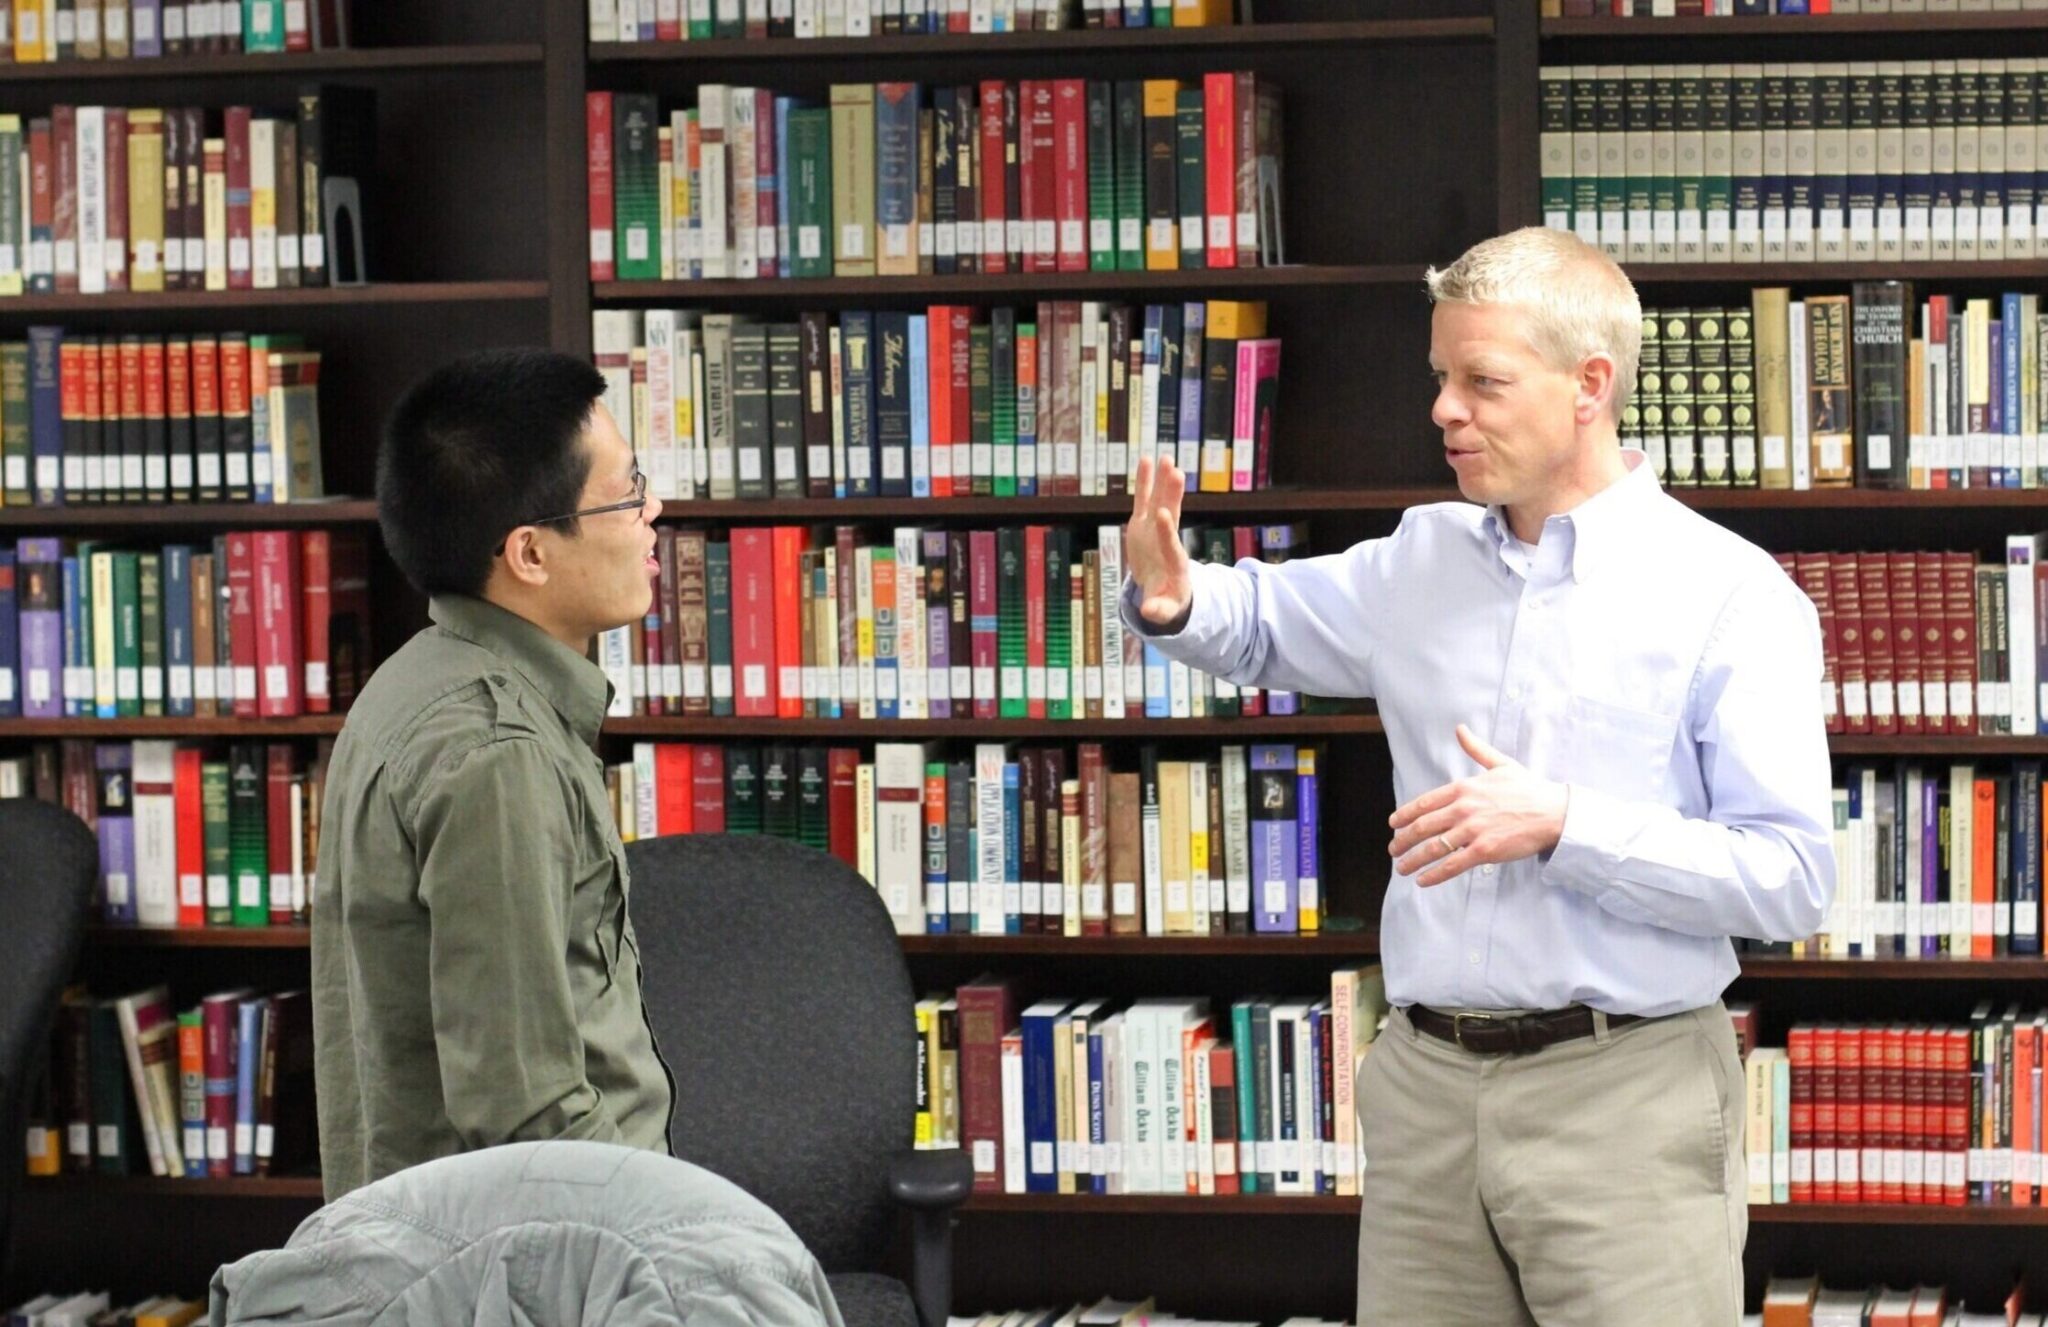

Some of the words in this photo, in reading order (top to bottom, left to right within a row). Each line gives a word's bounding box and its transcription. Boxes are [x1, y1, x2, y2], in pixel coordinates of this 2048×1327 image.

[1830, 303, 1844, 325] NEW
[1854, 326, 1902, 334] CHRISTIAN
[1813, 319, 1829, 382] THEOLOGY
[1854, 335, 1902, 344] CHURCH
[849, 386, 861, 444] HEBREWS
[1103, 565, 1120, 619] APPLICATION
[981, 782, 1002, 836] APPLICATION
[1335, 984, 1351, 1105] SELF-CONFRONTATION
[1090, 1080, 1102, 1110] DUNS
[1135, 1061, 1149, 1105] William
[1165, 1058, 1179, 1102] William
[1091, 1111, 1102, 1144] SCOTU
[1136, 1108, 1151, 1143] Ockha
[1166, 1106, 1180, 1141] Ockha
